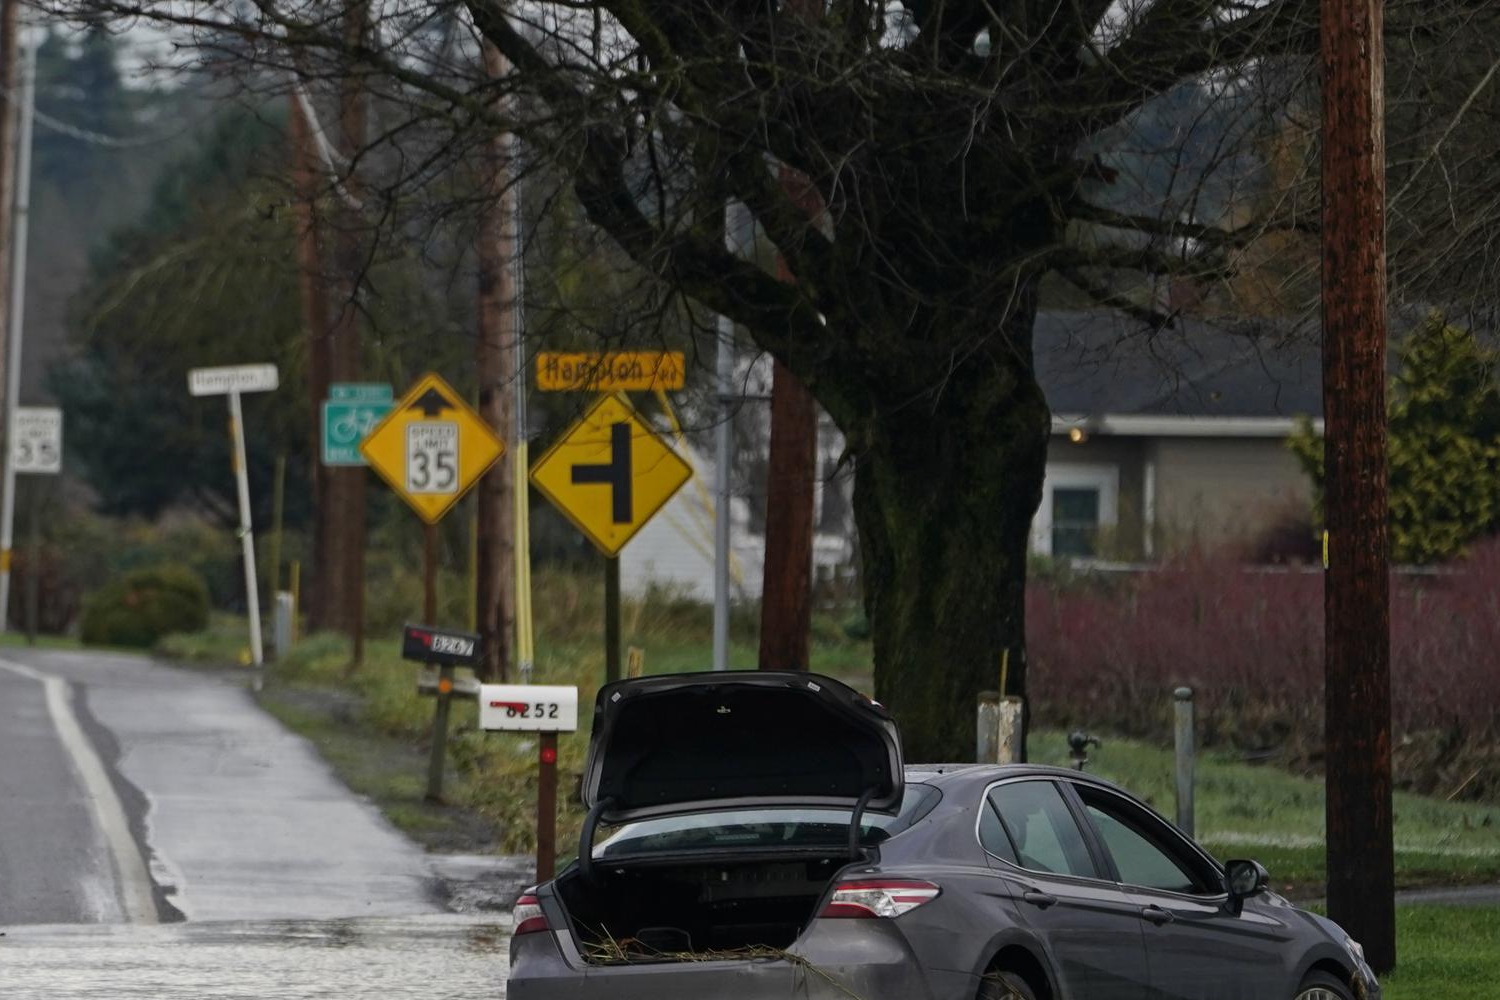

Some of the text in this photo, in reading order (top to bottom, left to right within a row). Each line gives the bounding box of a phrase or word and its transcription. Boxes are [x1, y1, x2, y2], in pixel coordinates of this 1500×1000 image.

[411, 427, 456, 437] SPEED
[416, 439, 449, 448] LIMIT
[411, 452, 456, 490] 35
